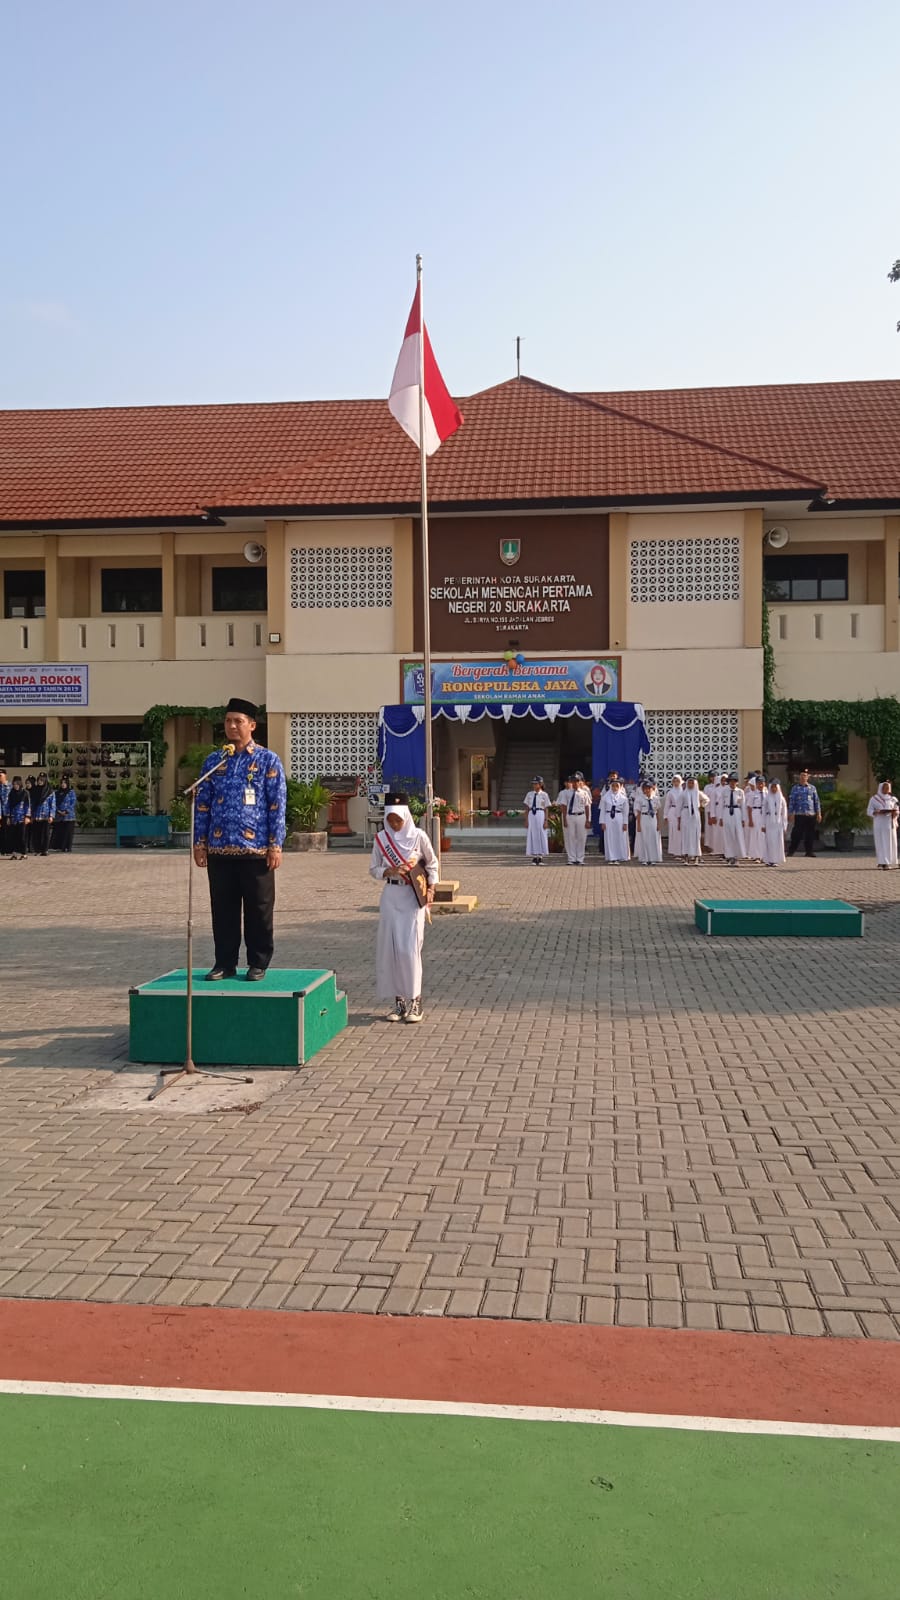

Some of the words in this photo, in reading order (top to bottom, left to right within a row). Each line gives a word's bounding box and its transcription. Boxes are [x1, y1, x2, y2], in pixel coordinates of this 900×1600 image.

[444, 576, 497, 585] PEERINTAH
[524, 575, 576, 583] SURAKARTA
[430, 587, 479, 599] SEKOLAH
[542, 584, 593, 598] PERTAMA
[448, 601, 487, 613] NEGERI
[489, 601, 502, 613] 20
[505, 600, 571, 612] SURAKARTA
[452, 664, 509, 680] Bergerak
[513, 664, 568, 676] Bersama
[0, 676, 36, 685] TANPA
[40, 675, 81, 684] ROKOK
[442, 682, 541, 692] RONGPULSKA
[544, 680, 578, 690] JAYA
